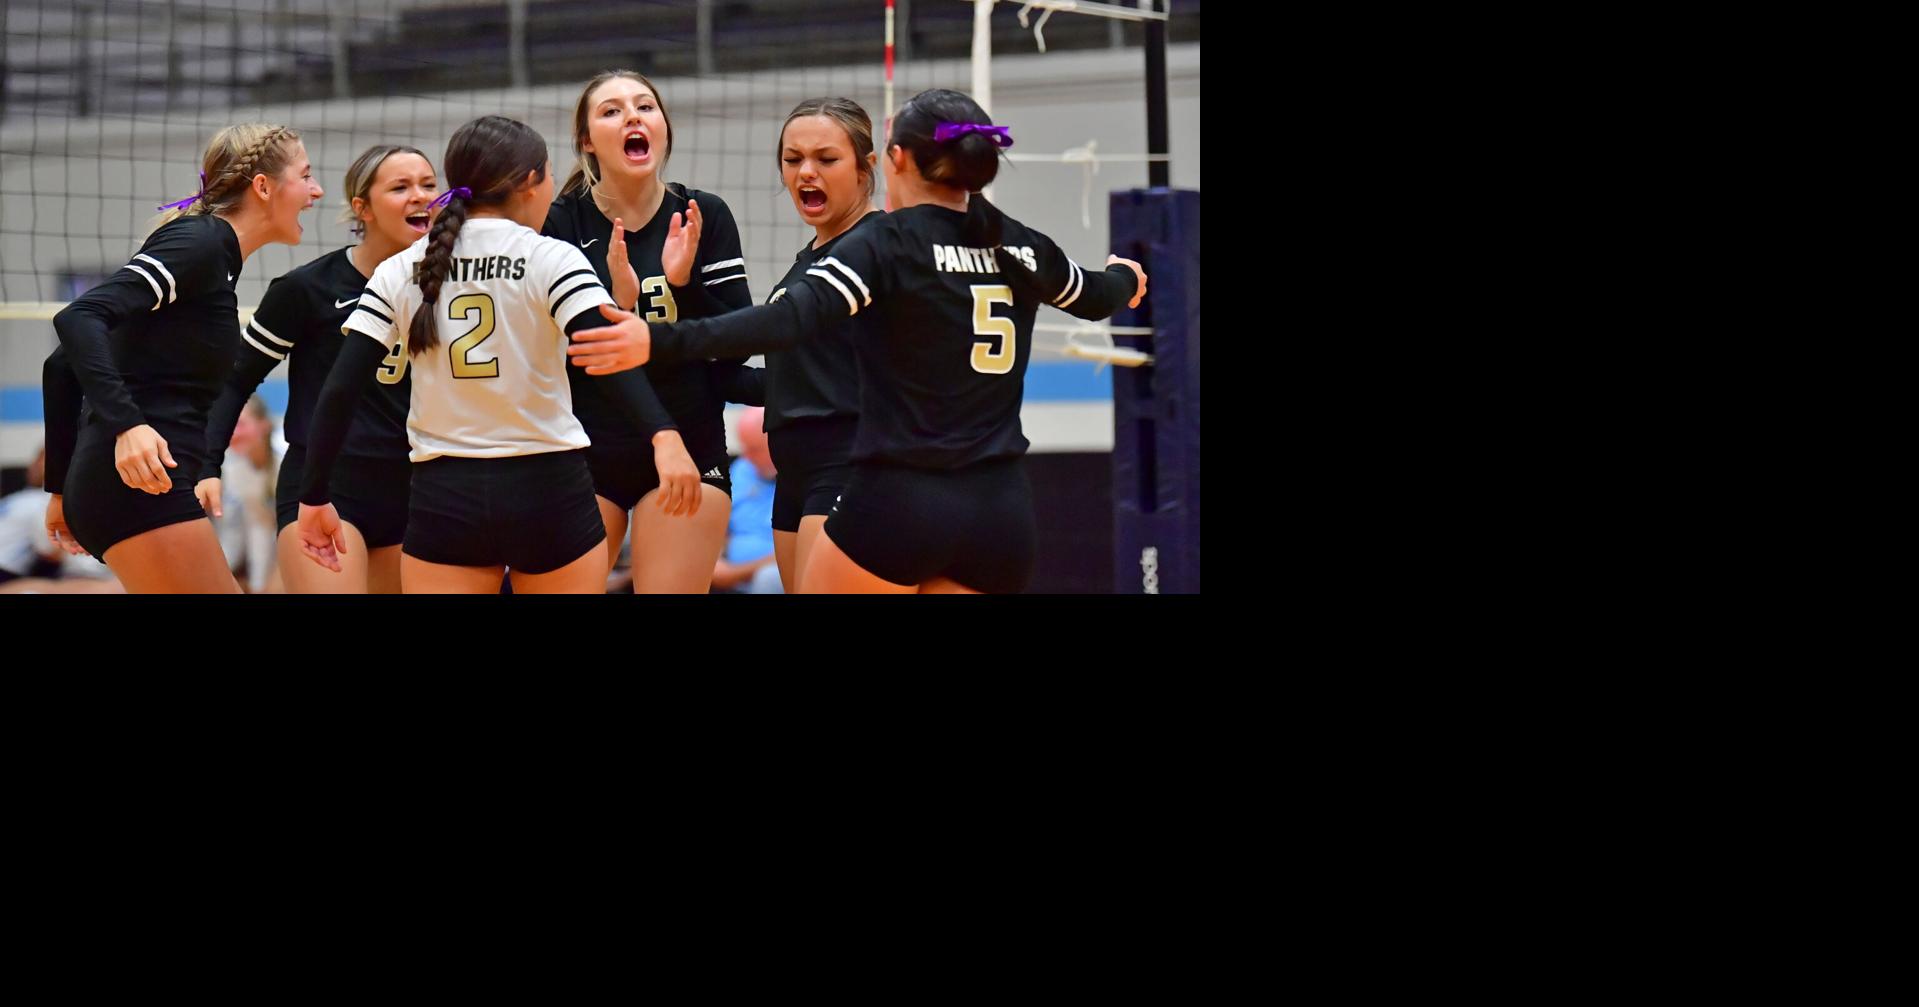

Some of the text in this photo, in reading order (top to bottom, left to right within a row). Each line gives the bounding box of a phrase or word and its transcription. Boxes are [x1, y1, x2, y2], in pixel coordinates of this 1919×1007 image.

[412, 255, 526, 285] NTHERS
[376, 336, 409, 385] 9
[448, 293, 500, 379] 2
[969, 284, 1016, 375] 5
